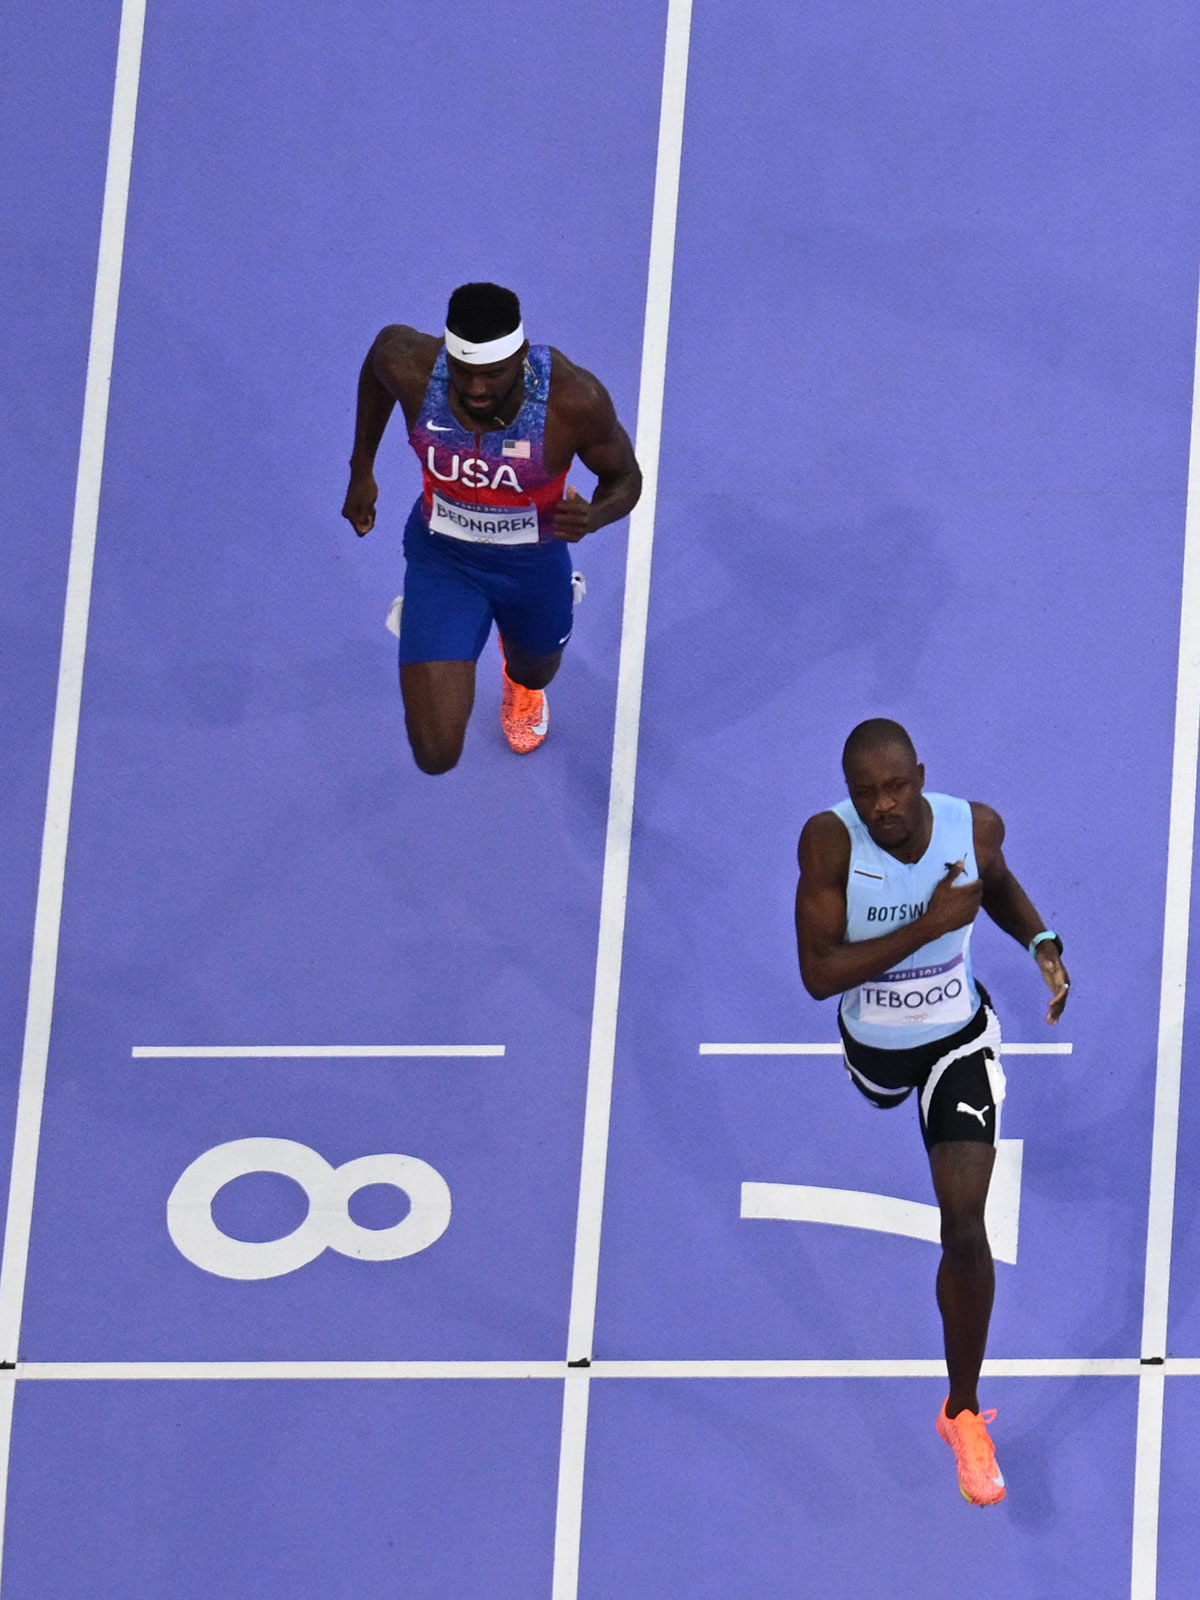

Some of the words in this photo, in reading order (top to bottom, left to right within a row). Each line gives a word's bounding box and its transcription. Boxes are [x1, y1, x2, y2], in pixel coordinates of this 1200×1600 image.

[427, 446, 524, 493] USA
[436, 503, 536, 534] BEDNAREK
[867, 901, 928, 921] BOTSW
[862, 978, 962, 1009] TEBOGO
[167, 1138, 451, 1281] 8
[740, 1138, 1024, 1265] 7
